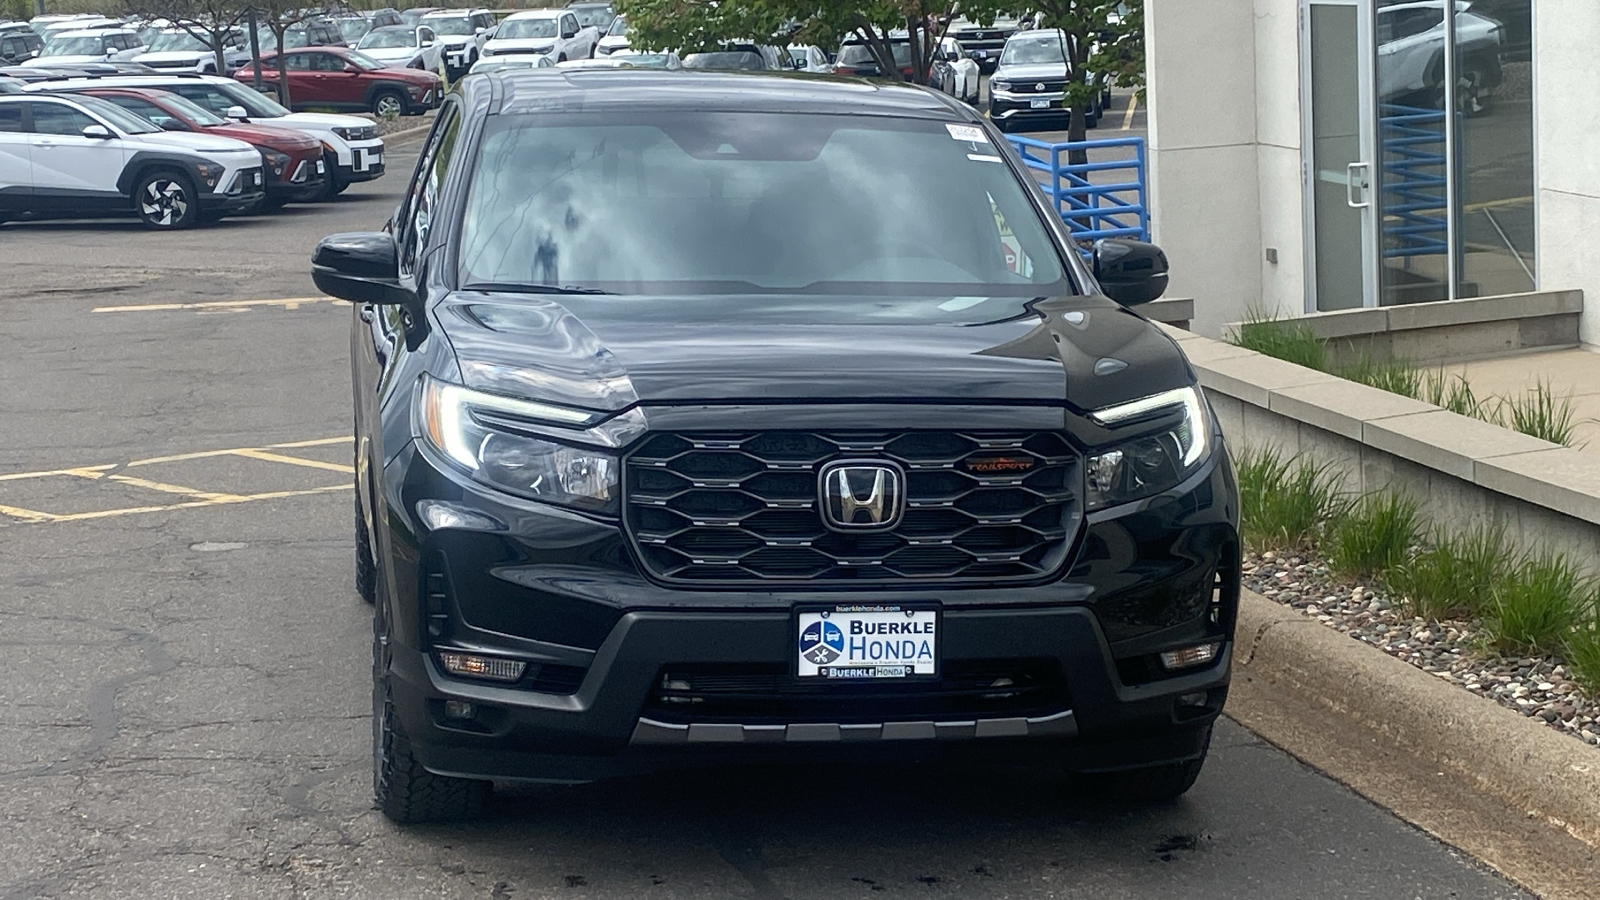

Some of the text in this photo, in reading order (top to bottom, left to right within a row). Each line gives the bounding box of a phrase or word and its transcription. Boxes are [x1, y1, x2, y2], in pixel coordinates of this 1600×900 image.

[849, 620, 934, 635] BUERKLE
[849, 636, 932, 660] HONDA
[829, 667, 903, 677] BUERKLE HONDA
